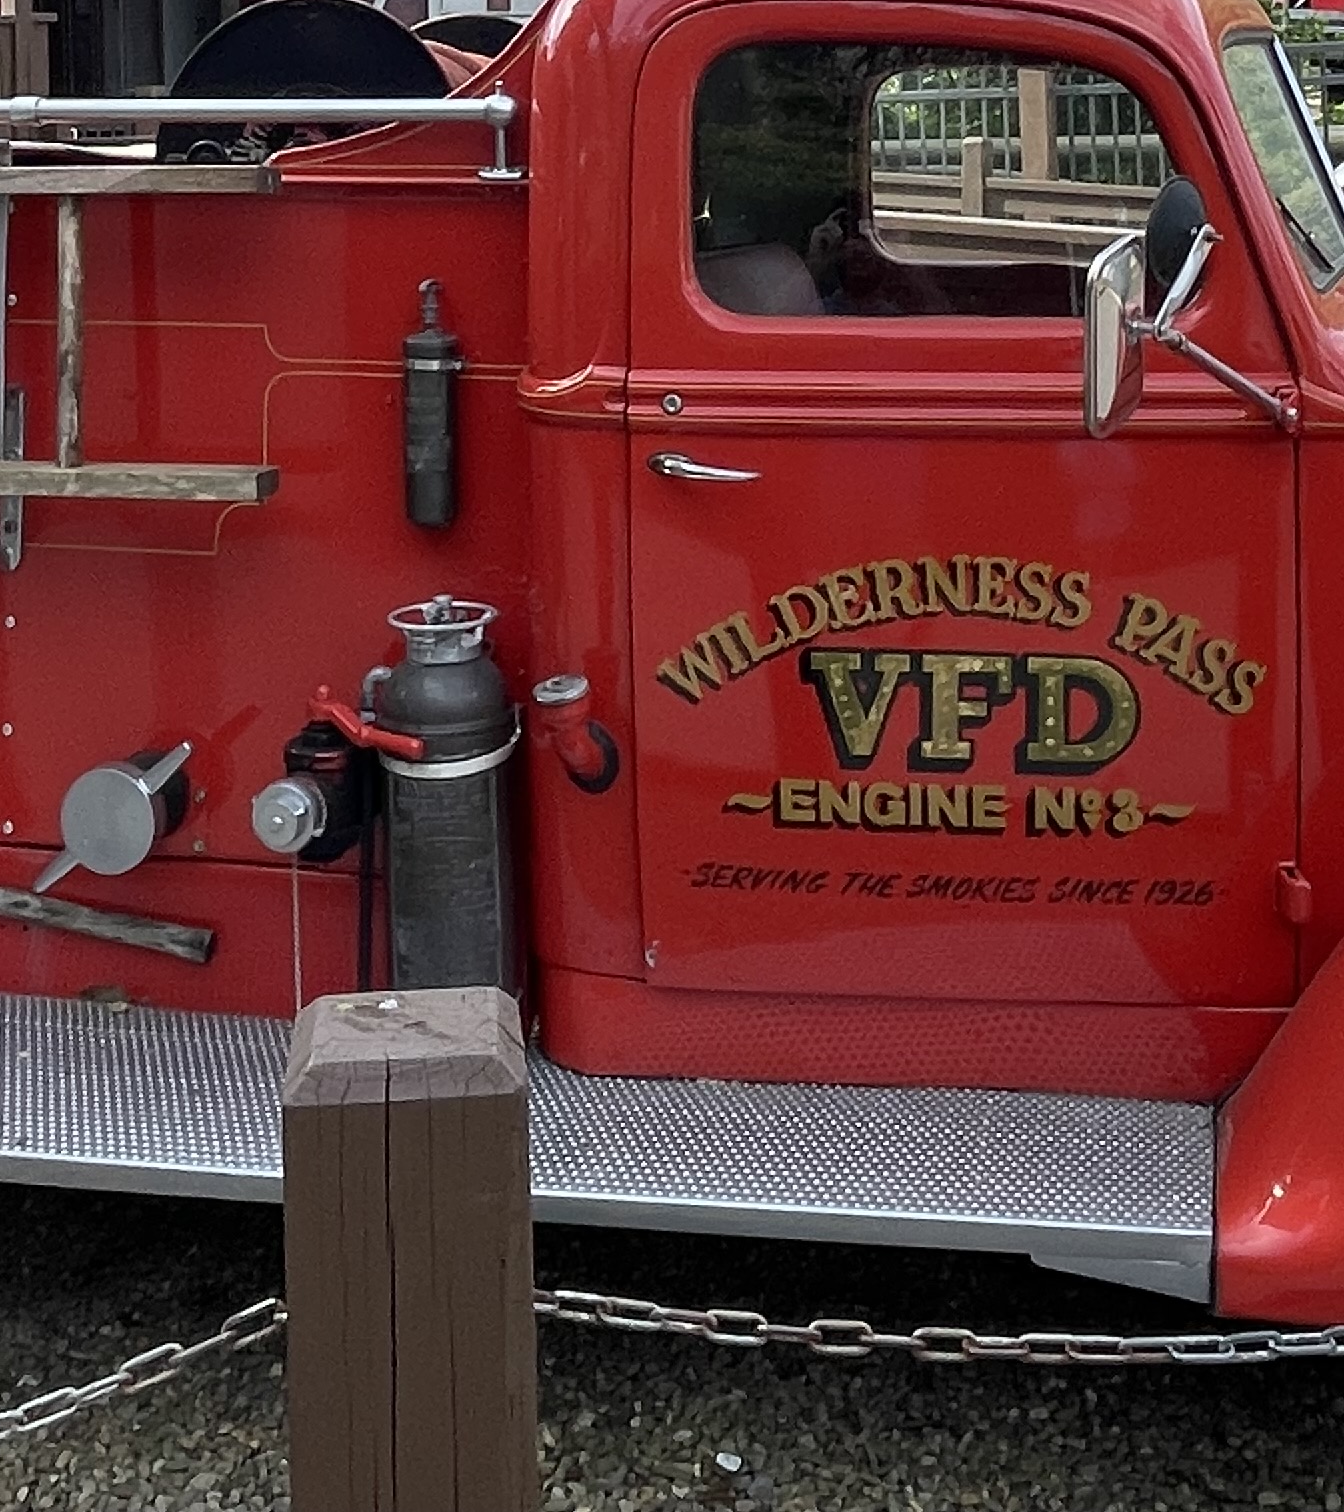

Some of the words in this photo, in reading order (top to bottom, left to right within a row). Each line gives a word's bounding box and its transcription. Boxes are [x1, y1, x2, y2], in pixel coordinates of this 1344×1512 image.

[657, 554, 1094, 703] WILDERNESS
[1114, 592, 1267, 716] PASS
[801, 648, 1141, 775] VFD
[774, 777, 1008, 834] ENGINE
[689, 861, 830, 895] SERVING
[842, 869, 896, 900] THE
[905, 872, 1040, 905] SMOKIES
[1047, 875, 1141, 905] SINCE
[1143, 877, 1215, 907] 1926
